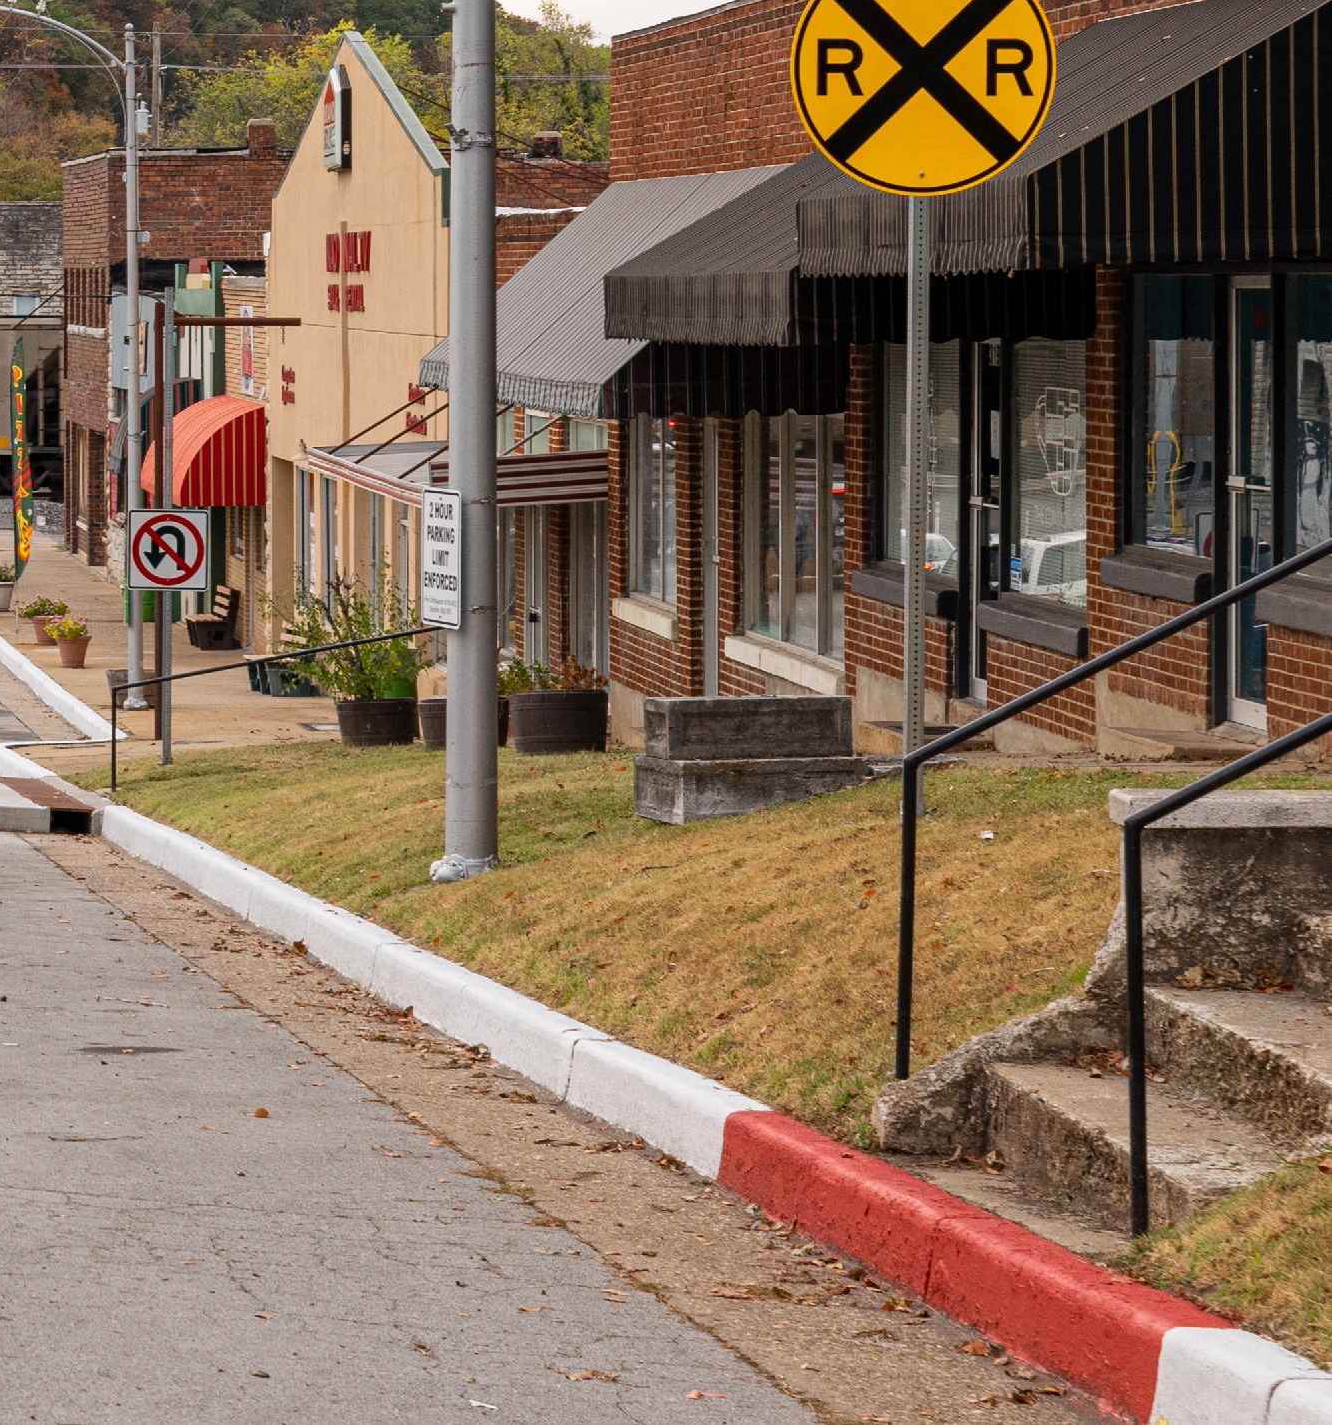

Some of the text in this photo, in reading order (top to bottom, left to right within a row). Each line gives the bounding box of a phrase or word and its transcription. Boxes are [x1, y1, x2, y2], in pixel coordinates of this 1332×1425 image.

[817, 38, 1034, 96] R R
[12, 365, 30, 499] PIZZA
[429, 501, 454, 521] 2 HOUR
[427, 524, 455, 545] PARKING
[432, 549, 450, 567] LIMIT
[424, 571, 457, 592] ENFORCED
